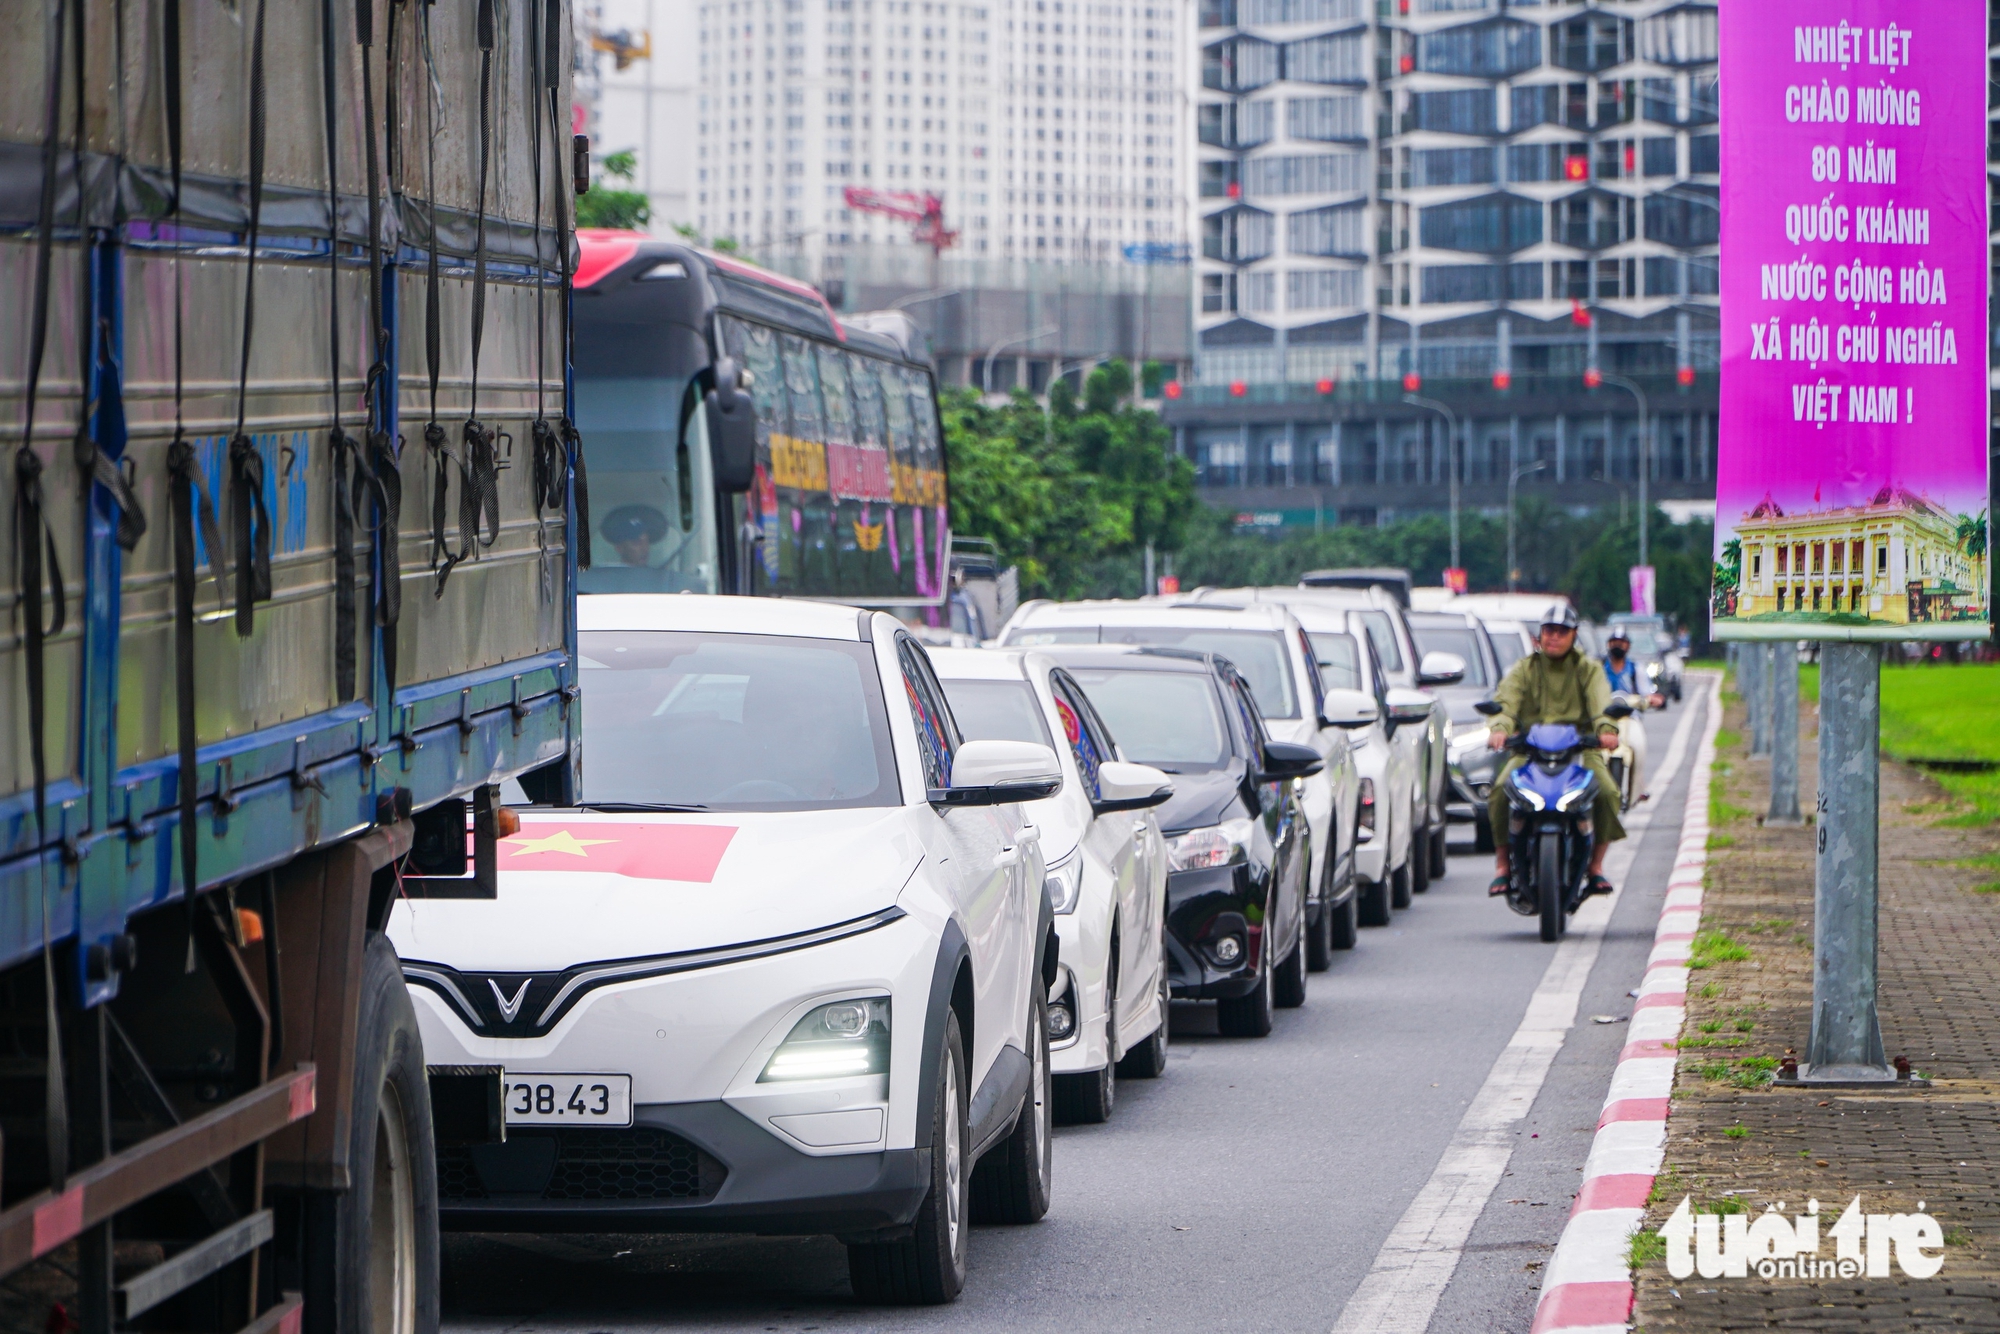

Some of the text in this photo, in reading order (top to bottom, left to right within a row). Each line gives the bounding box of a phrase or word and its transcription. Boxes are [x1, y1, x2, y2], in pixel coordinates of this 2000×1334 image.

[1795, 19, 1912, 73] NHIỆT LIỆT
[1786, 78, 1920, 126] CHÀO MỪNG
[1812, 139, 1896, 184] 80 NĂM
[1786, 192, 1929, 245] QUỐC KHÁNH
[1761, 253, 1947, 310] NƯỚC CỘNG HÒA
[1751, 311, 1957, 369] XÃ HỘI CHỦ NGHĨA
[1793, 378, 1841, 429] VIỆT
[1849, 386, 1897, 424] NAM
